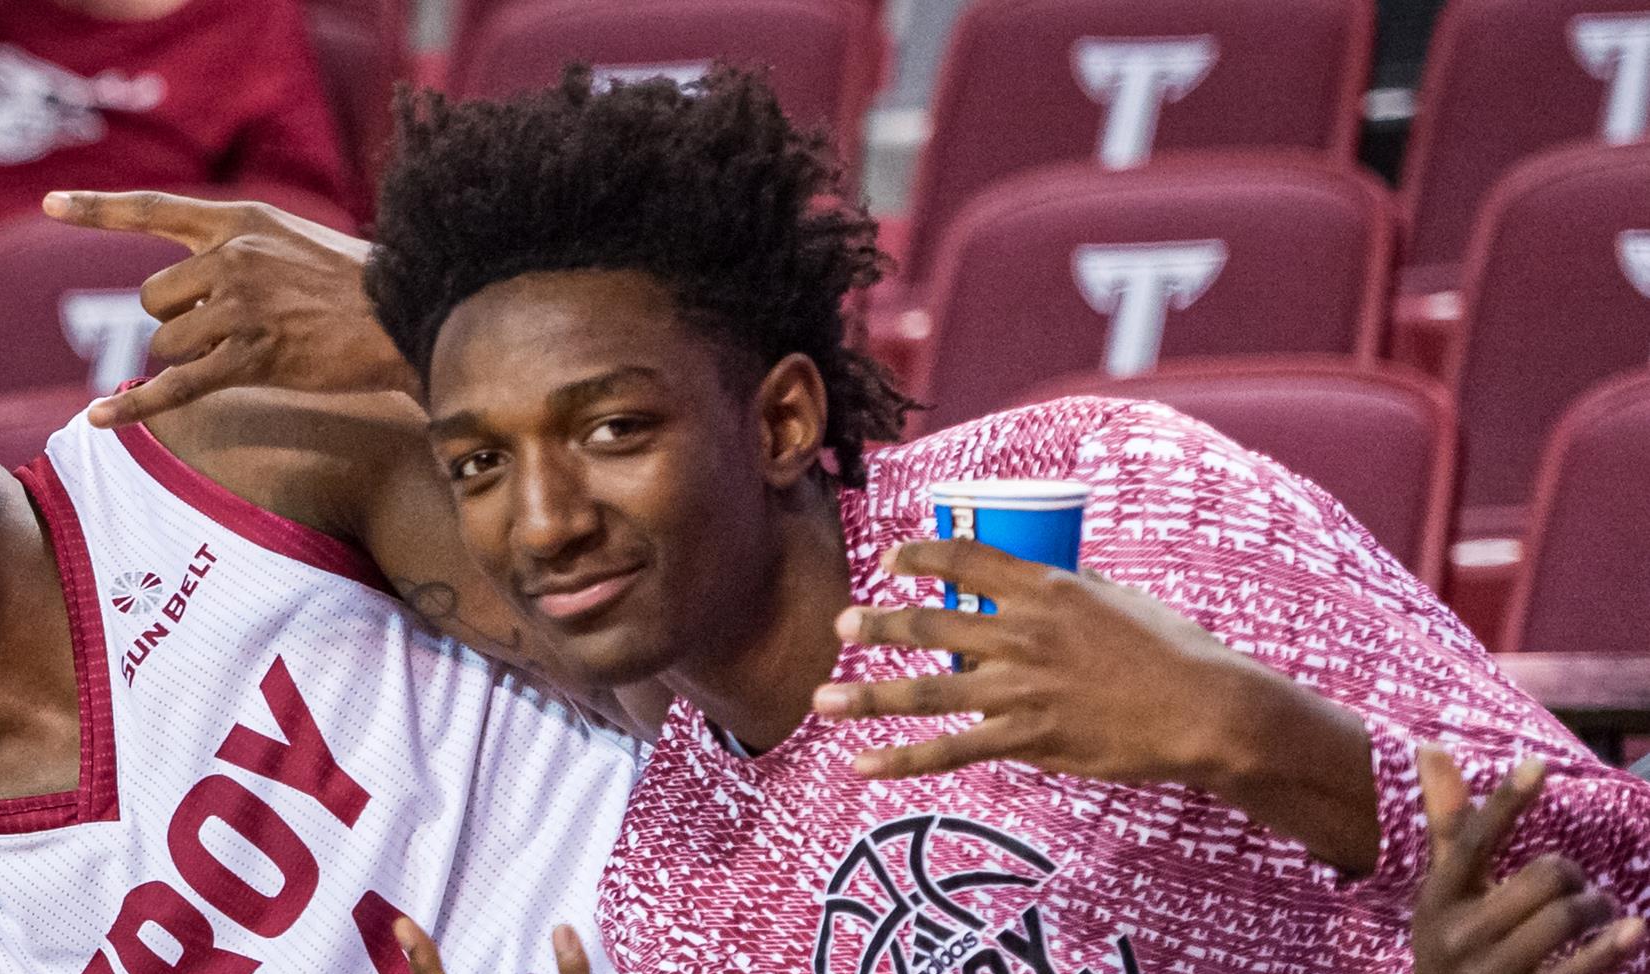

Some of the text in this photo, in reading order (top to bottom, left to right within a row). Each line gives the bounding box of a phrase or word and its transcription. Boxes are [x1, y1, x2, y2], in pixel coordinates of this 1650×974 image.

[1073, 36, 1219, 170] T
[1074, 240, 1228, 379] T
[121, 543, 217, 688] SUN BELT
